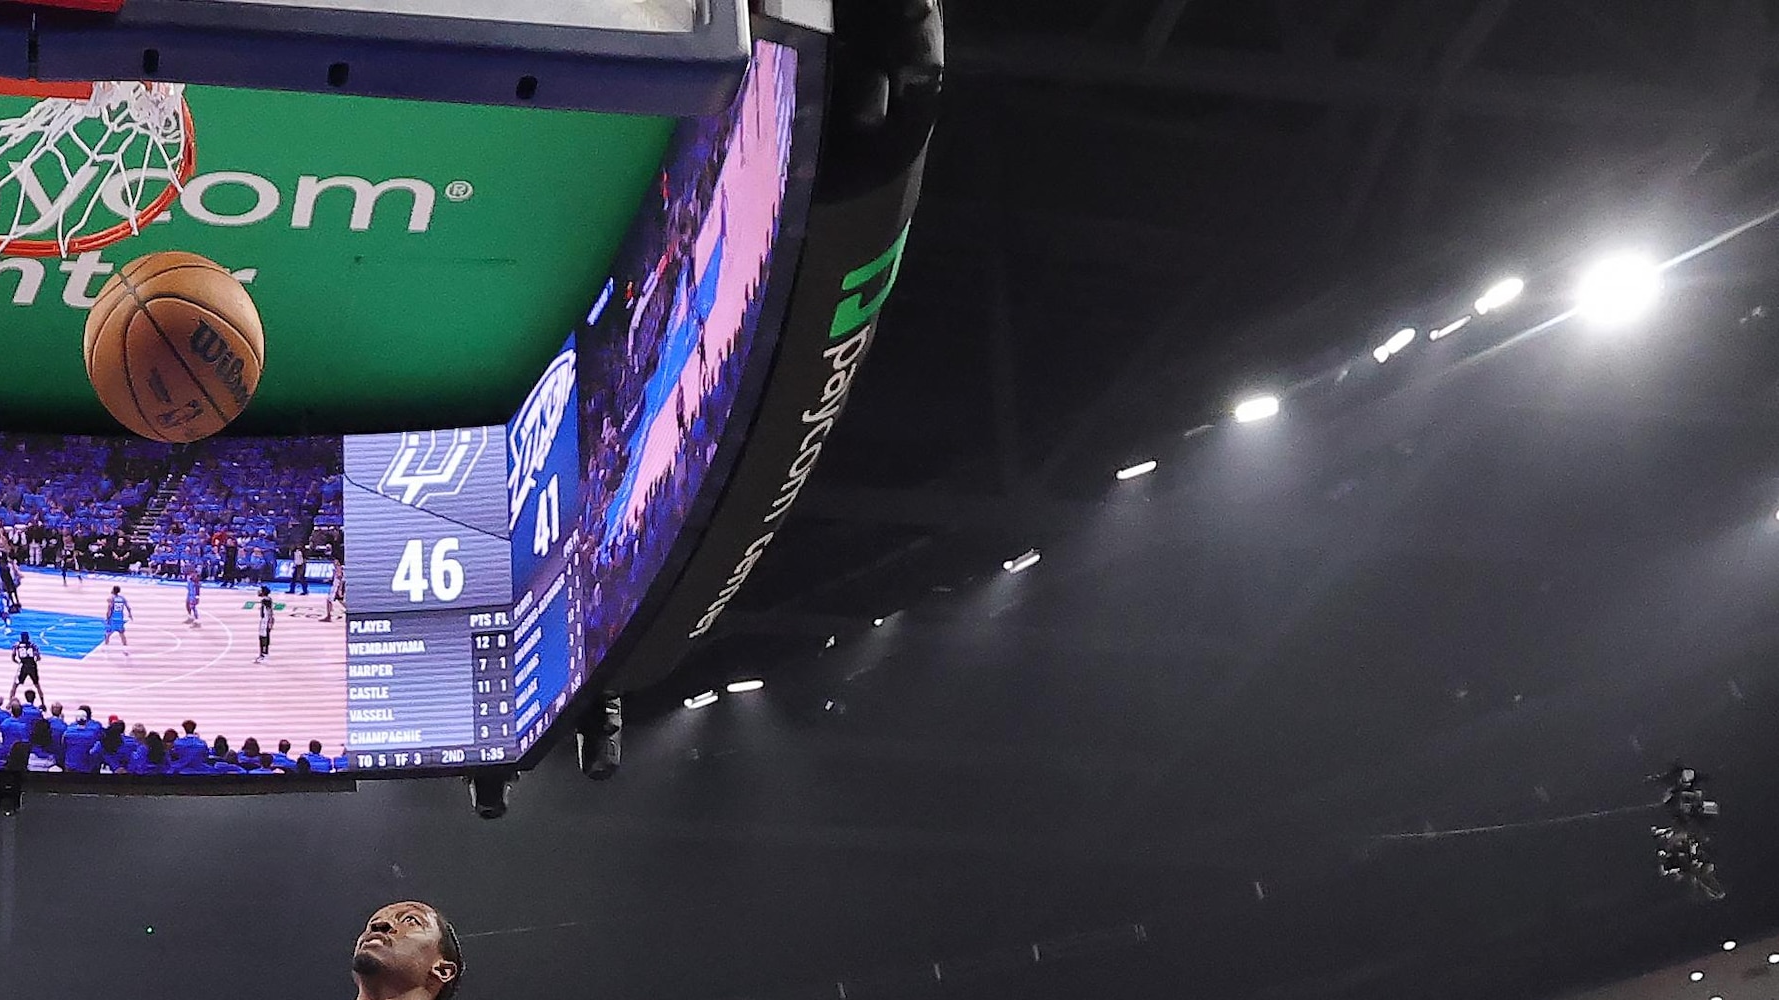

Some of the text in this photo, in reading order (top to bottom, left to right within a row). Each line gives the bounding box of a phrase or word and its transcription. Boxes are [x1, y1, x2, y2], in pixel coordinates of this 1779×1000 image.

[764, 322, 871, 524] paycom
[533, 473, 561, 557] 41
[391, 537, 465, 603] 46
[349, 612, 509, 634] PLAYER PTS FL
[348, 634, 507, 656] WEMBANYAMA 12 0
[349, 656, 507, 677] HARPER 7 1
[349, 678, 508, 700] CASTLE 11 1
[349, 701, 509, 722] VASSELL 2 0
[349, 723, 509, 745] CHAMPAGNIE 3 1
[357, 747, 505, 768] TO 5 TF 3 2ND 1:35
